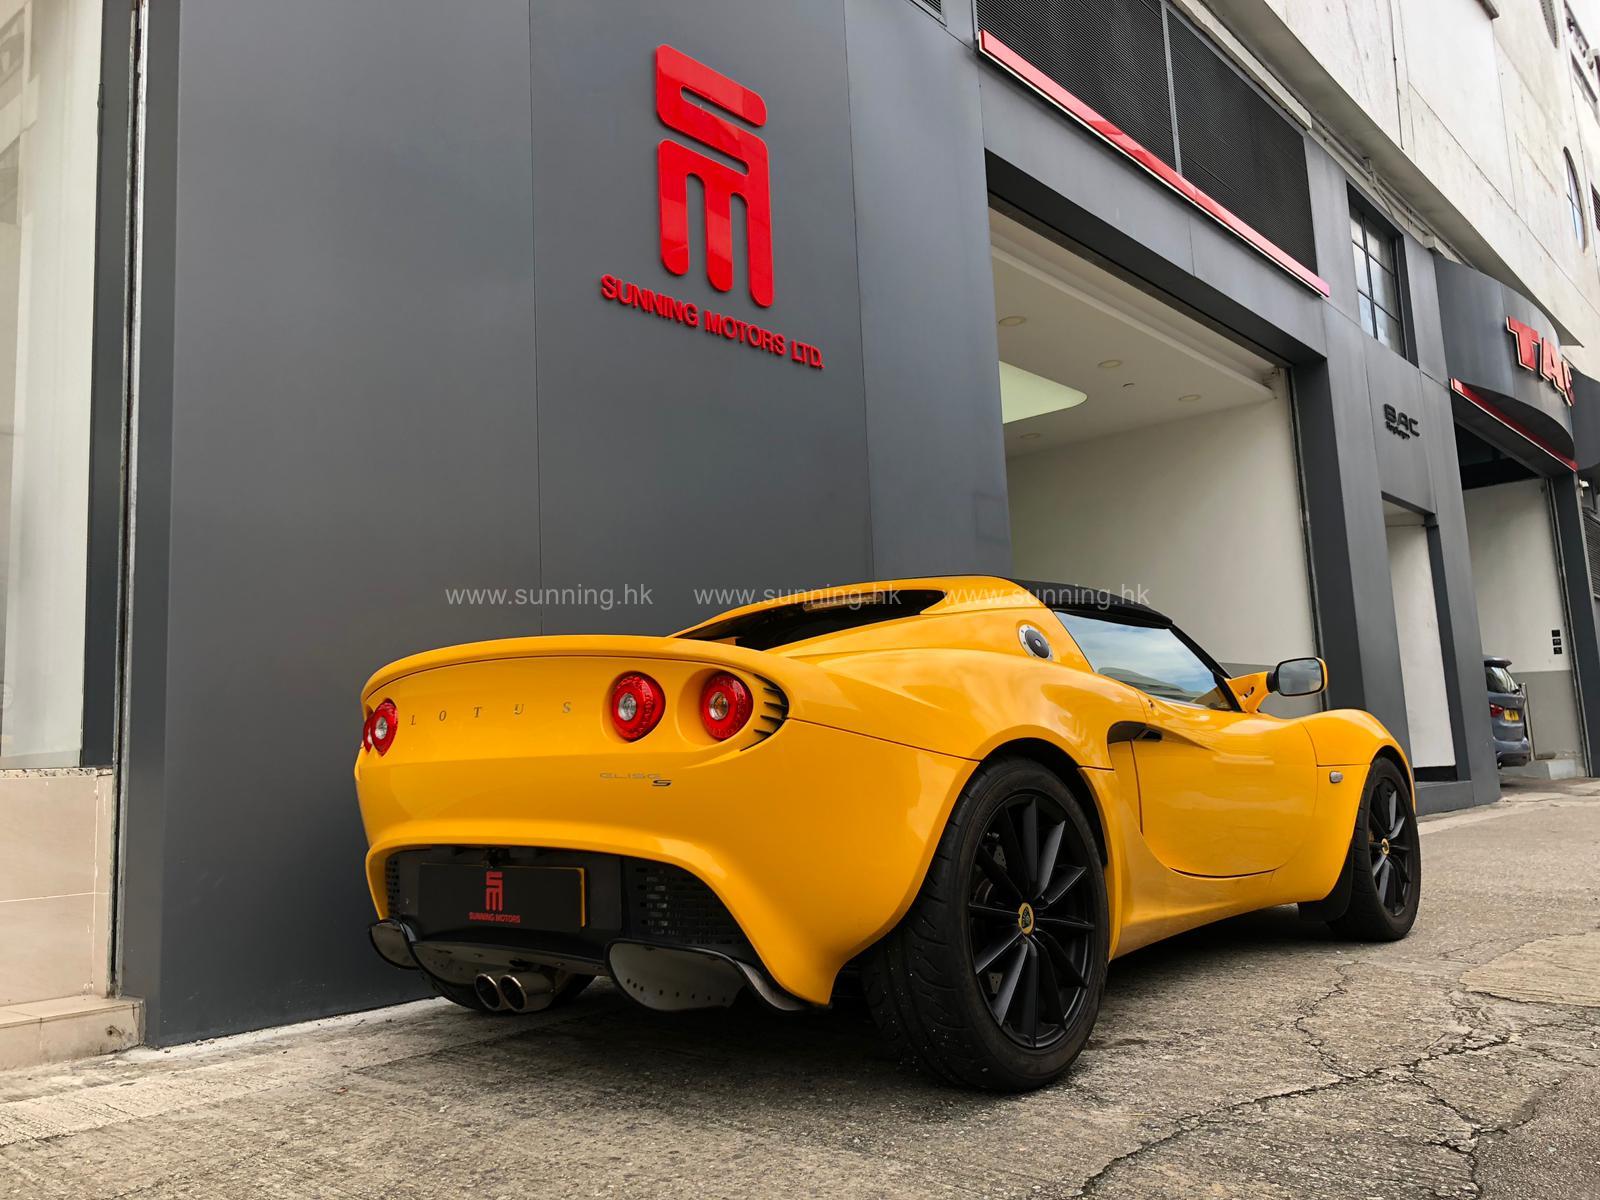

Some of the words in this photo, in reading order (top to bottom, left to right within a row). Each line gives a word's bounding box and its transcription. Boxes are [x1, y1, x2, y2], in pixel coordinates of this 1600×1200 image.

[600, 273, 699, 327] SUNNING
[703, 309, 787, 356] MOTORS
[1383, 403, 1420, 437] BAC
